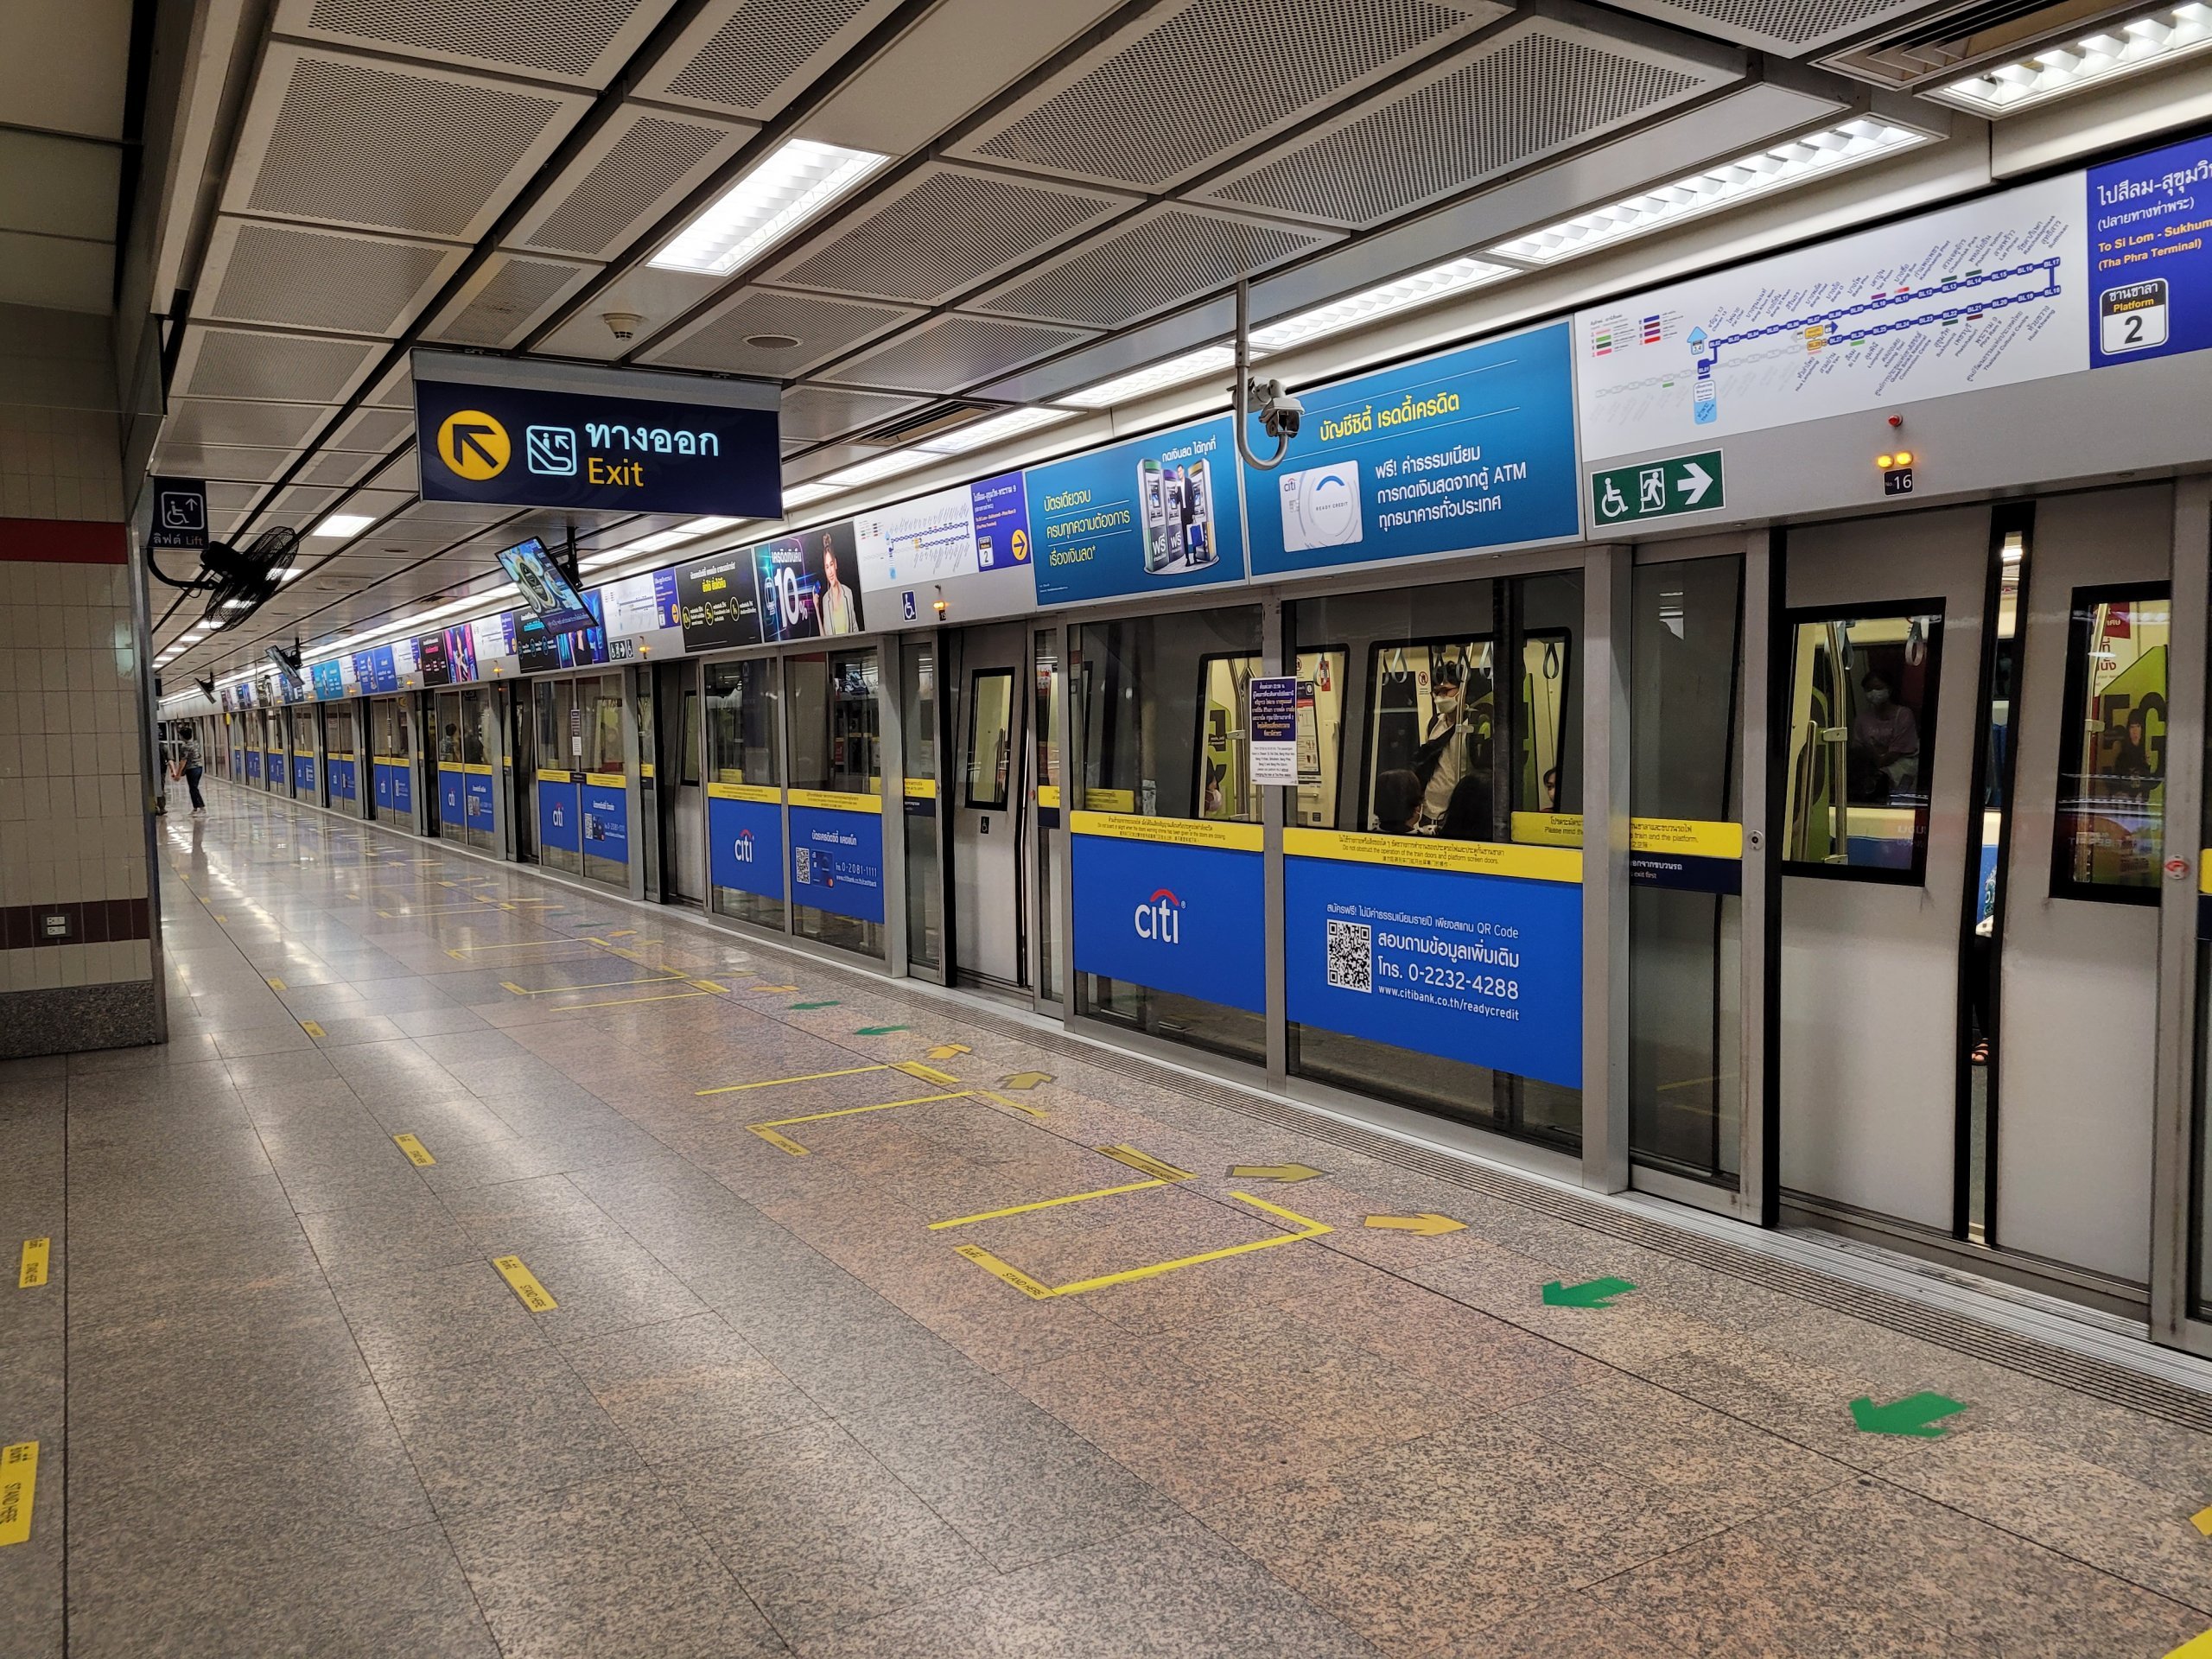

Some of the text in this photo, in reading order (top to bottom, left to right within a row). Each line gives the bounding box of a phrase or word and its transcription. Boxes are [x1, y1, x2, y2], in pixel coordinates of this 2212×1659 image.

[2098, 197, 2195, 232] (ปลายทางท่าพระ)
[2099, 243, 2112, 252] To
[2114, 238, 2126, 249] Si
[2129, 232, 2154, 245] Lom
[2044, 259, 2060, 268] BL17
[2099, 238, 2202, 271] (Tha Phra Terminal)
[1992, 271, 2007, 280] BL15
[2018, 265, 2033, 274] BL16
[1942, 283, 1957, 292] BL13
[1967, 277, 1981, 286] BL14
[2109, 282, 2158, 302] ชานชาลา
[2113, 297, 2154, 313] Platform
[2125, 315, 2143, 345] 2
[1319, 392, 1459, 442] บัญชีซิตี้ เรดดี้เครดิต
[585, 422, 720, 458] ทางออก
[1162, 435, 1217, 463] กดเงินสด ได้ทุกที่
[588, 457, 644, 488] Exit
[1376, 445, 1481, 480] ฟรี! ค่าธรรมเนียม
[1284, 480, 1296, 493] citi
[1377, 461, 1527, 505] การกดเงินสดจากตู้ ATM
[1894, 474, 1911, 490] 16
[1044, 489, 1091, 512] บัตรเดียวจบ
[1315, 500, 1349, 512] READY CREDIT
[1046, 510, 1130, 539] ครบทุกความต้องการ
[1379, 495, 1502, 532] ทุกธนาคารทั่วประเทศ
[153, 530, 181, 546] ลิฟต์
[186, 535, 203, 546] Lift
[1152, 533, 1166, 556] ฟรี
[1170, 530, 1182, 550] ฟรี
[983, 550, 989, 563] 2
[1544, 825, 1562, 834] Please
[1634, 831, 1647, 840] train
[1672, 835, 1699, 843] platform.
[734, 835, 753, 863] citi
[842, 862, 877, 877] 0-2081-1111
[1135, 898, 1179, 944] citi
[1326, 903, 1519, 939] สมัครฟรี! ไม่มีค่าธรรมเนียมรายปี เพียงสแกน QR Code
[1378, 932, 1519, 968] สอบถามข้อมูลเพิ่มเติม
[1378, 956, 1519, 1000] โทร. 0-2232-4288
[1378, 984, 1520, 1021] www.citibank.co.th/readycredit
[1001, 1272, 1045, 1297] STAND HERE
